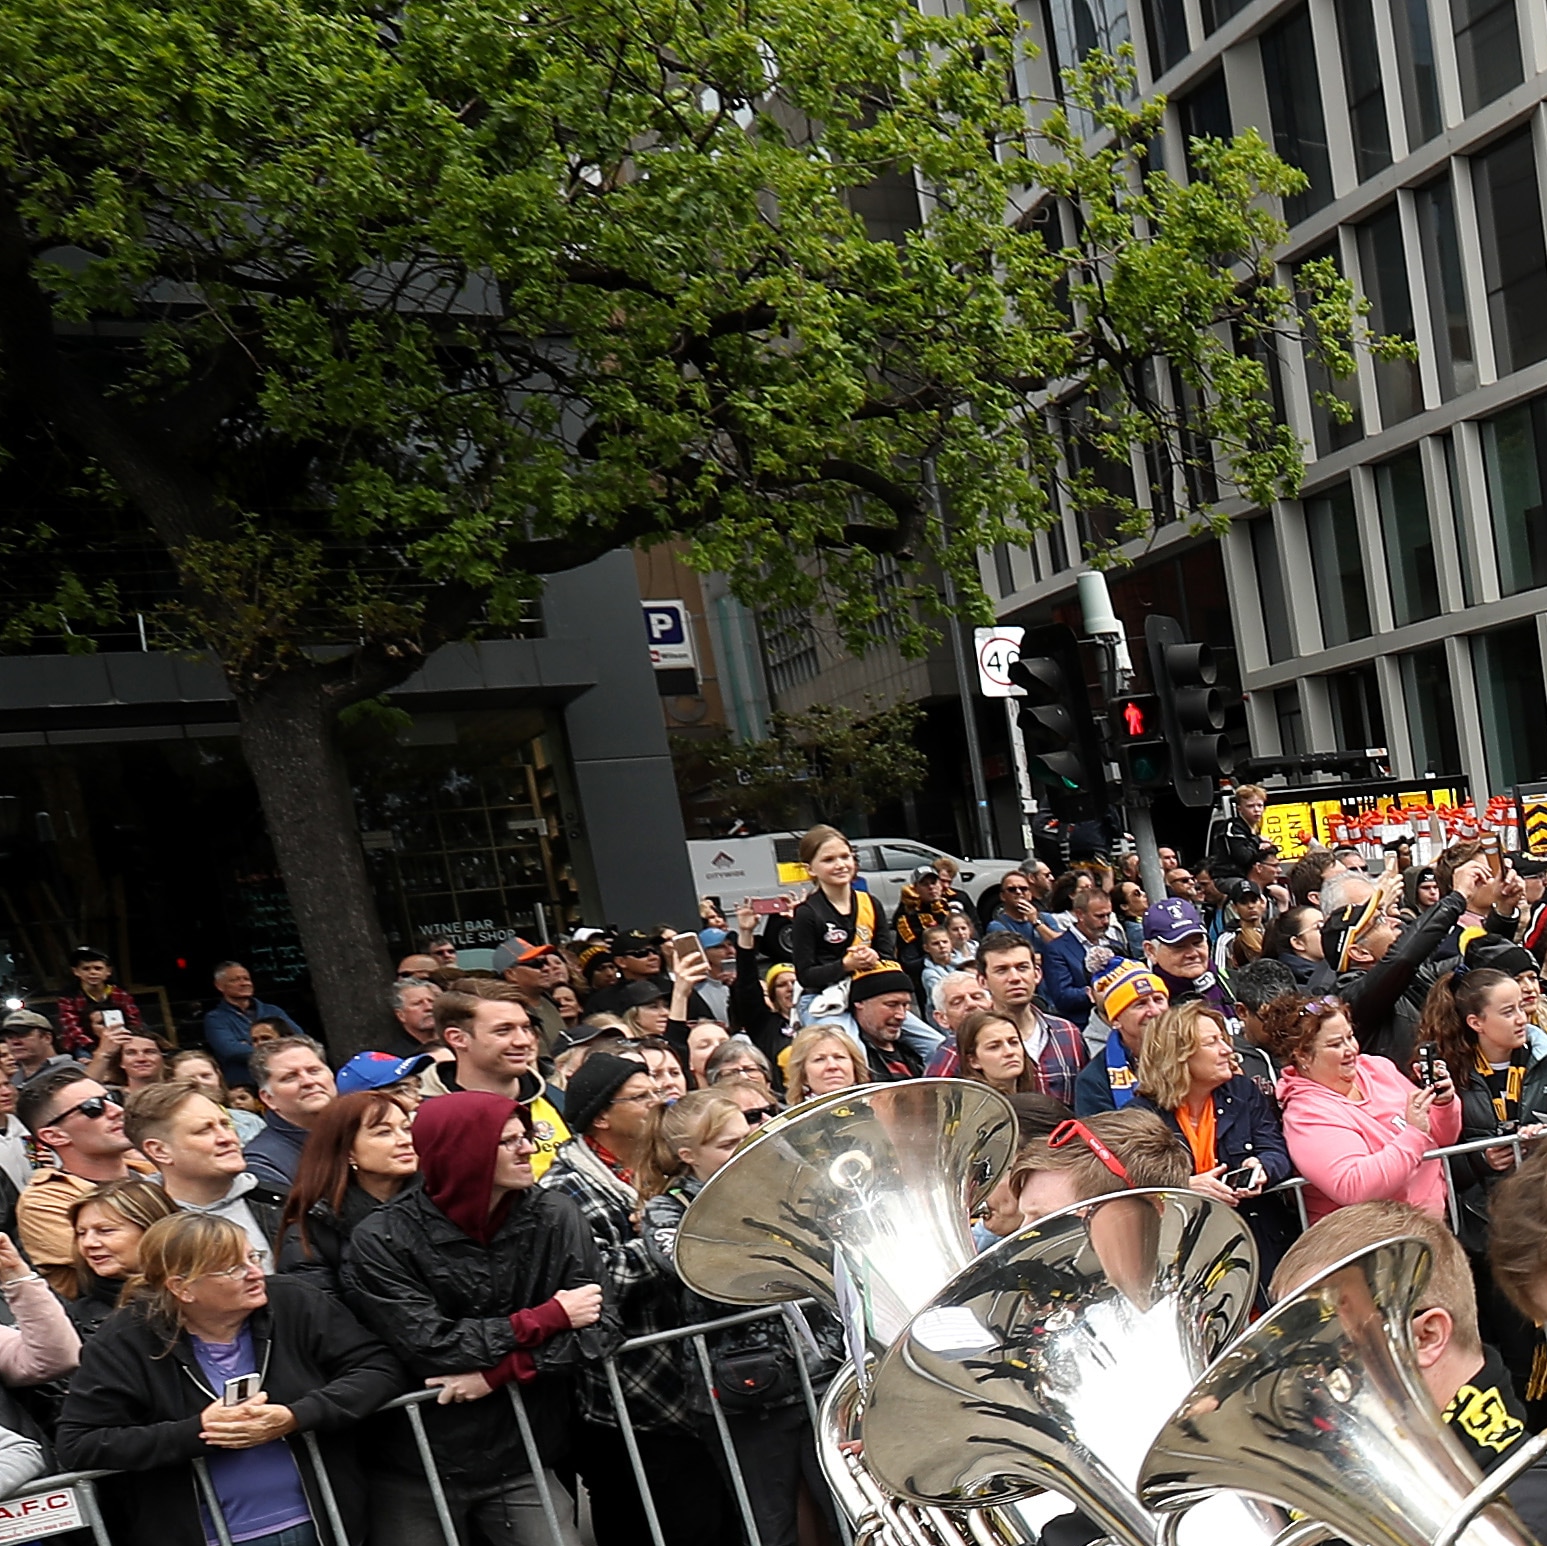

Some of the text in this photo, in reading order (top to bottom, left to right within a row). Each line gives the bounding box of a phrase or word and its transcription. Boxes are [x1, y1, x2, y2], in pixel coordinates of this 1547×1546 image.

[705, 870, 746, 880] CITYWIDE
[418, 919, 495, 936] WINE BAR
[446, 929, 516, 945] TLE SHOP
